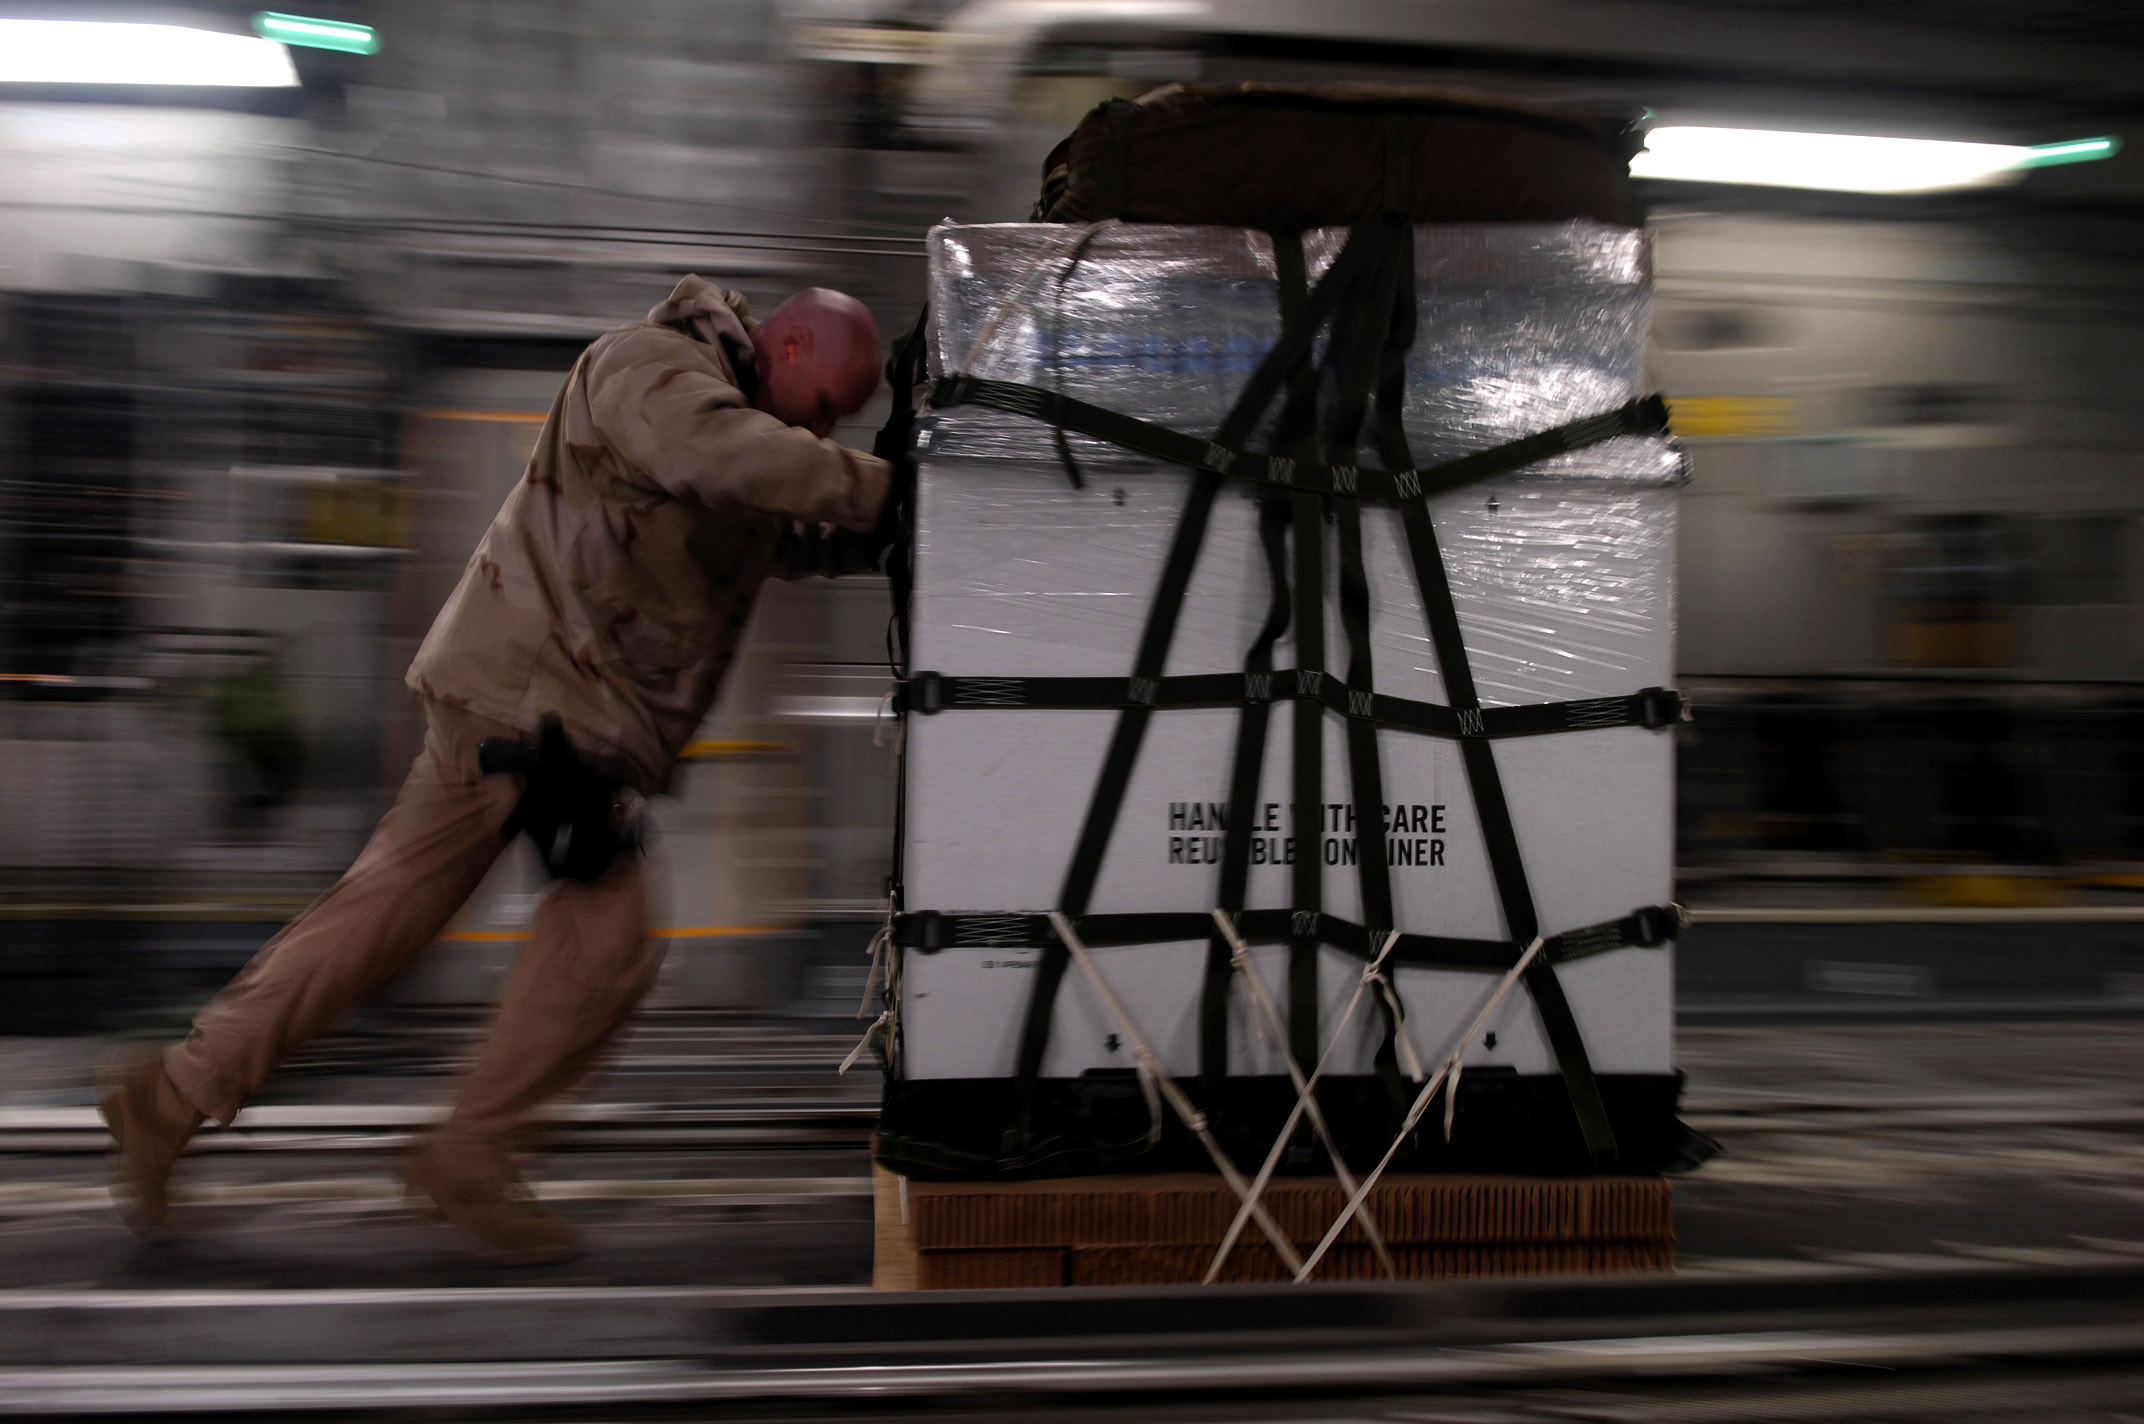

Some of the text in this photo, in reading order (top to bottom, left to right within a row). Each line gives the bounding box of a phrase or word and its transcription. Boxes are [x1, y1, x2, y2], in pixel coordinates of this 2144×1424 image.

[1169, 802, 1280, 831] HANE
[1290, 803, 1358, 832] ITH
[1169, 836, 1445, 866] REUBLE ONINER
